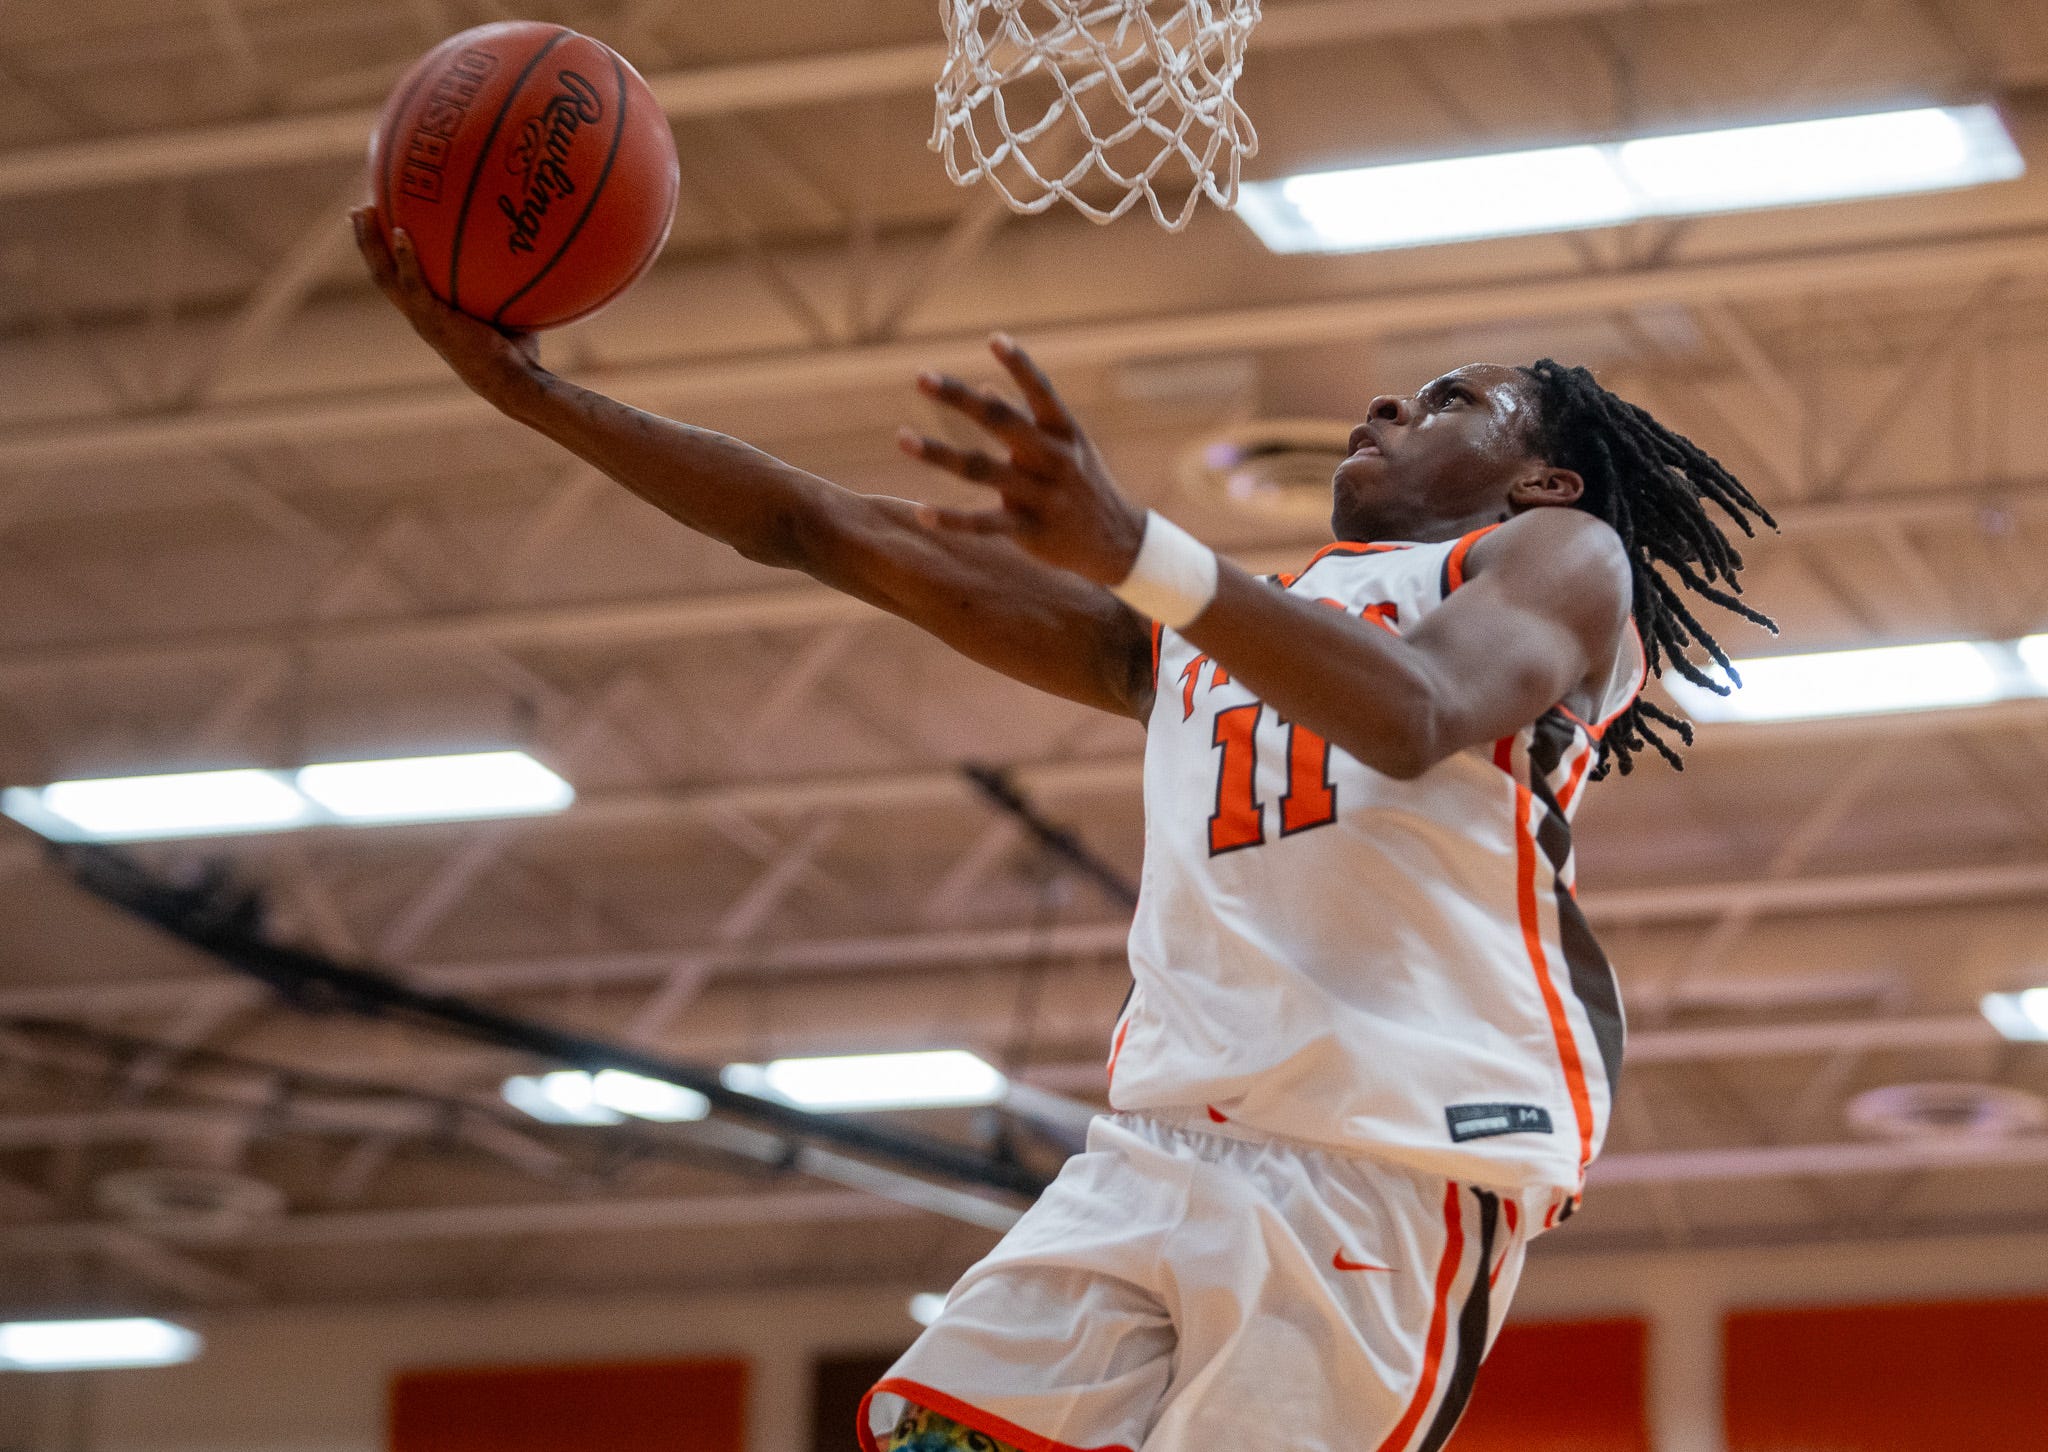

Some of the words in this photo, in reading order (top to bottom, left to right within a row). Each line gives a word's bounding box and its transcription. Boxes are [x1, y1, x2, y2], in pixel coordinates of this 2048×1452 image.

[401, 49, 498, 204] OHSAA
[498, 69, 602, 255] Rawlings
[1208, 700, 1337, 858] 11
